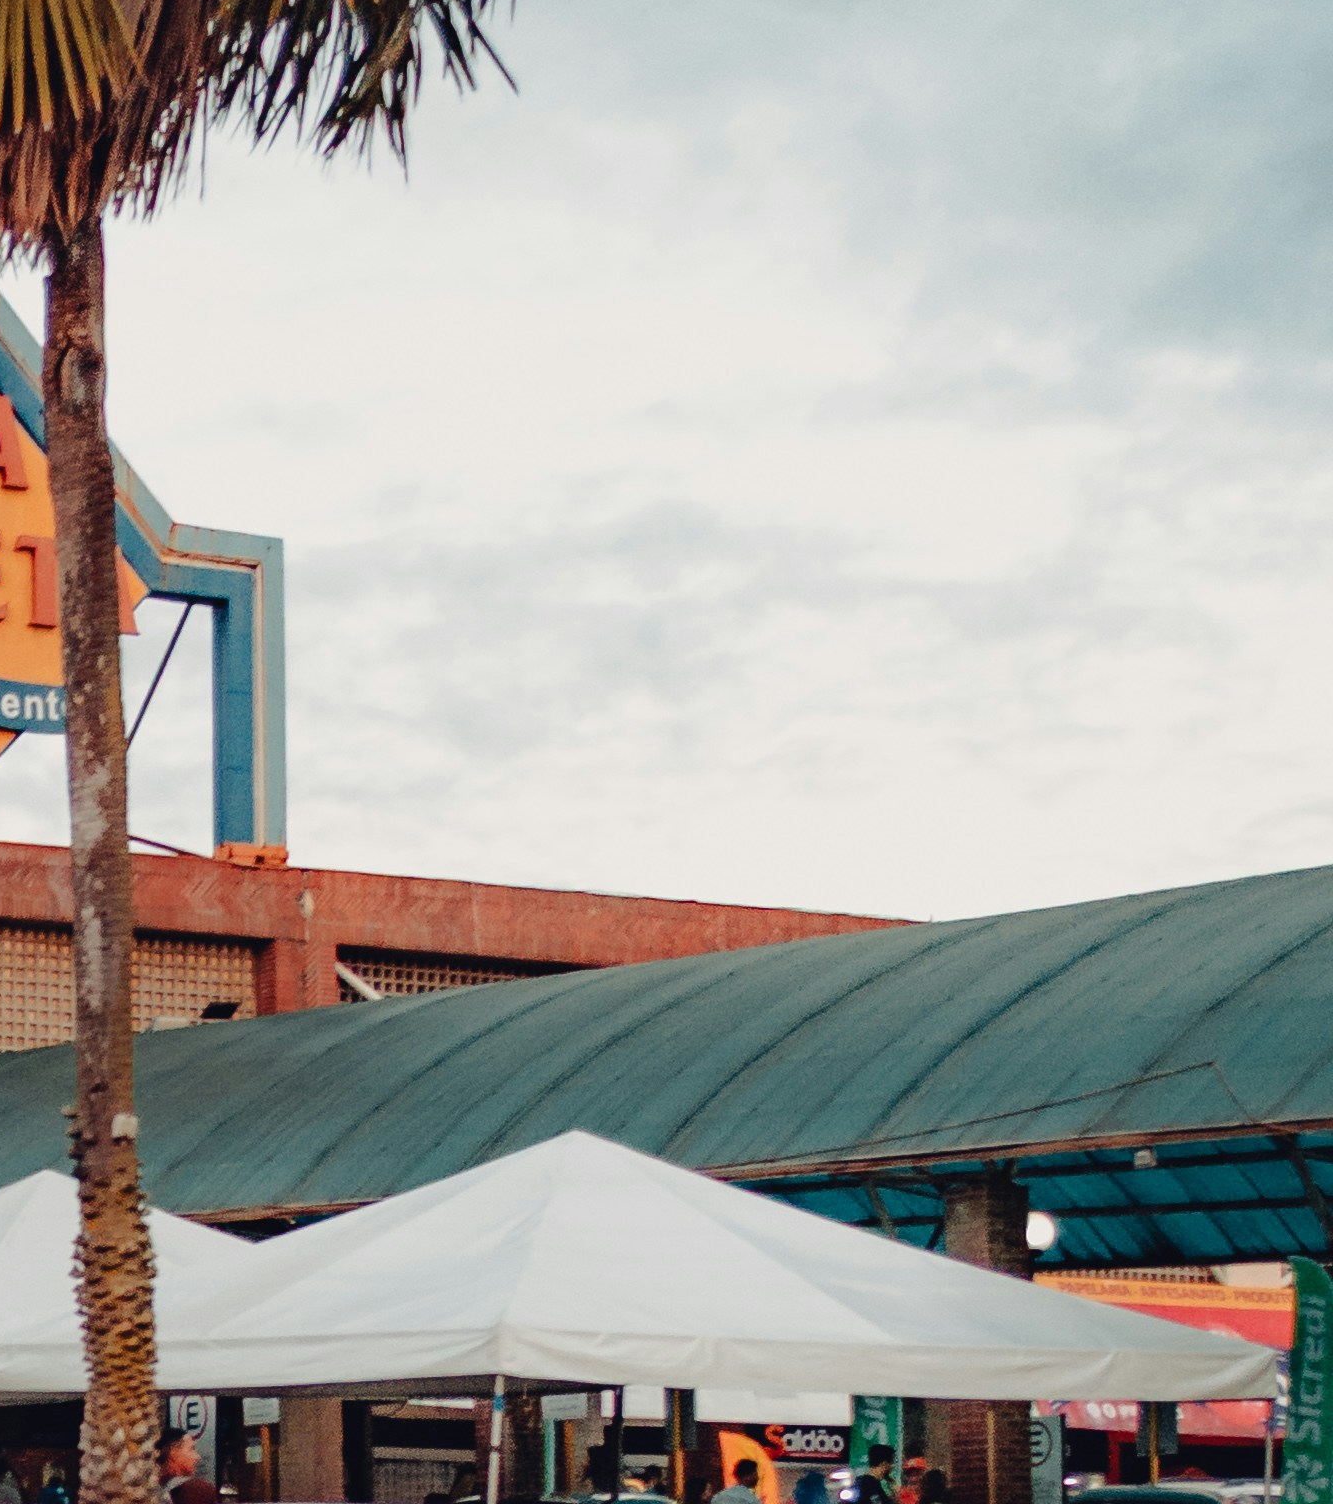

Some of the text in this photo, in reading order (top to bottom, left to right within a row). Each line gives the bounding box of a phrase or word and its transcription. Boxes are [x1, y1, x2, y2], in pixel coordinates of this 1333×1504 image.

[1286, 1296, 1327, 1445] Sicredi
[186, 1401, 201, 1431] E
[764, 1424, 845, 1460] Saldão
